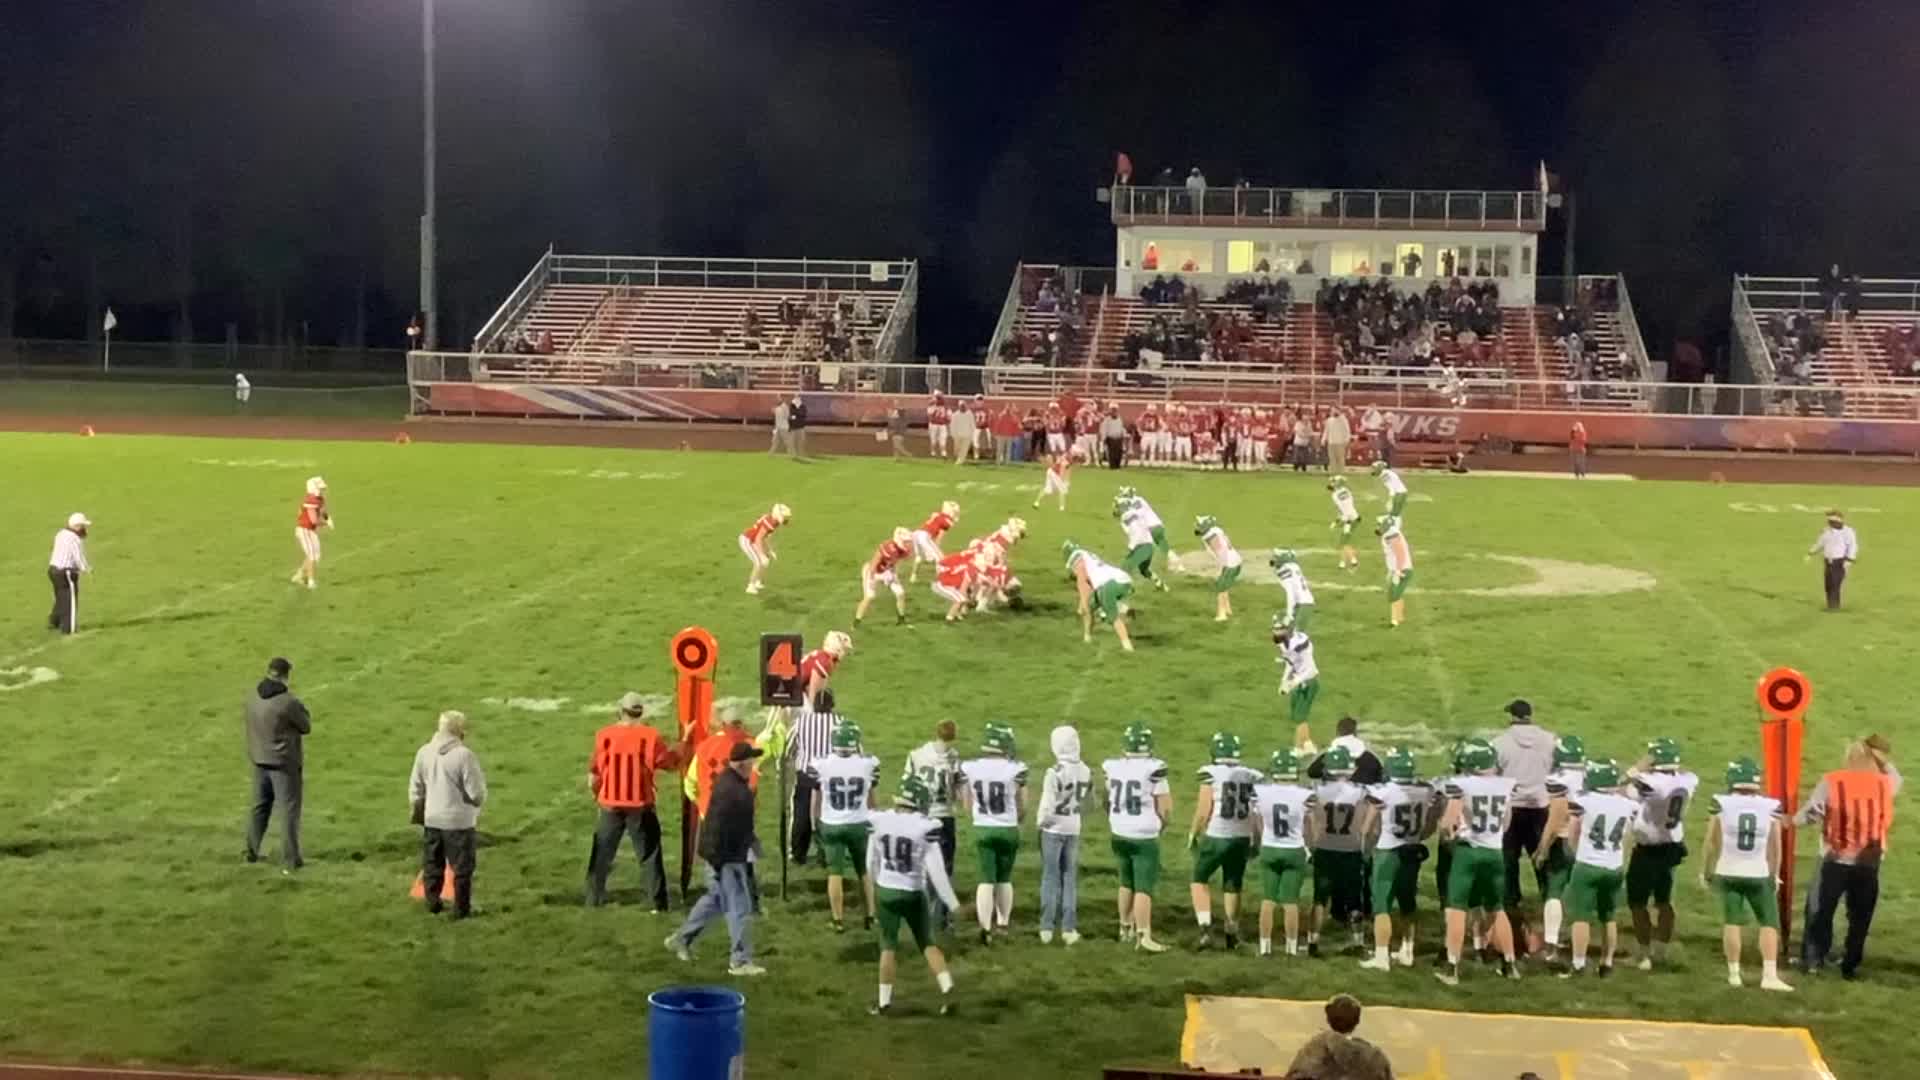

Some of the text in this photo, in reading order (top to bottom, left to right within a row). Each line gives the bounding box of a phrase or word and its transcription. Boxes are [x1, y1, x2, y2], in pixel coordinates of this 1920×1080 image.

[768, 640, 797, 680] 4
[829, 776, 865, 811] 62
[1110, 779, 1142, 816] 76
[1273, 803, 1291, 838] 6
[1323, 800, 1355, 836] 17
[1394, 802, 1424, 839] 51
[1471, 795, 1506, 835] 55
[1589, 813, 1628, 852] 44
[1738, 813, 1757, 851] 8
